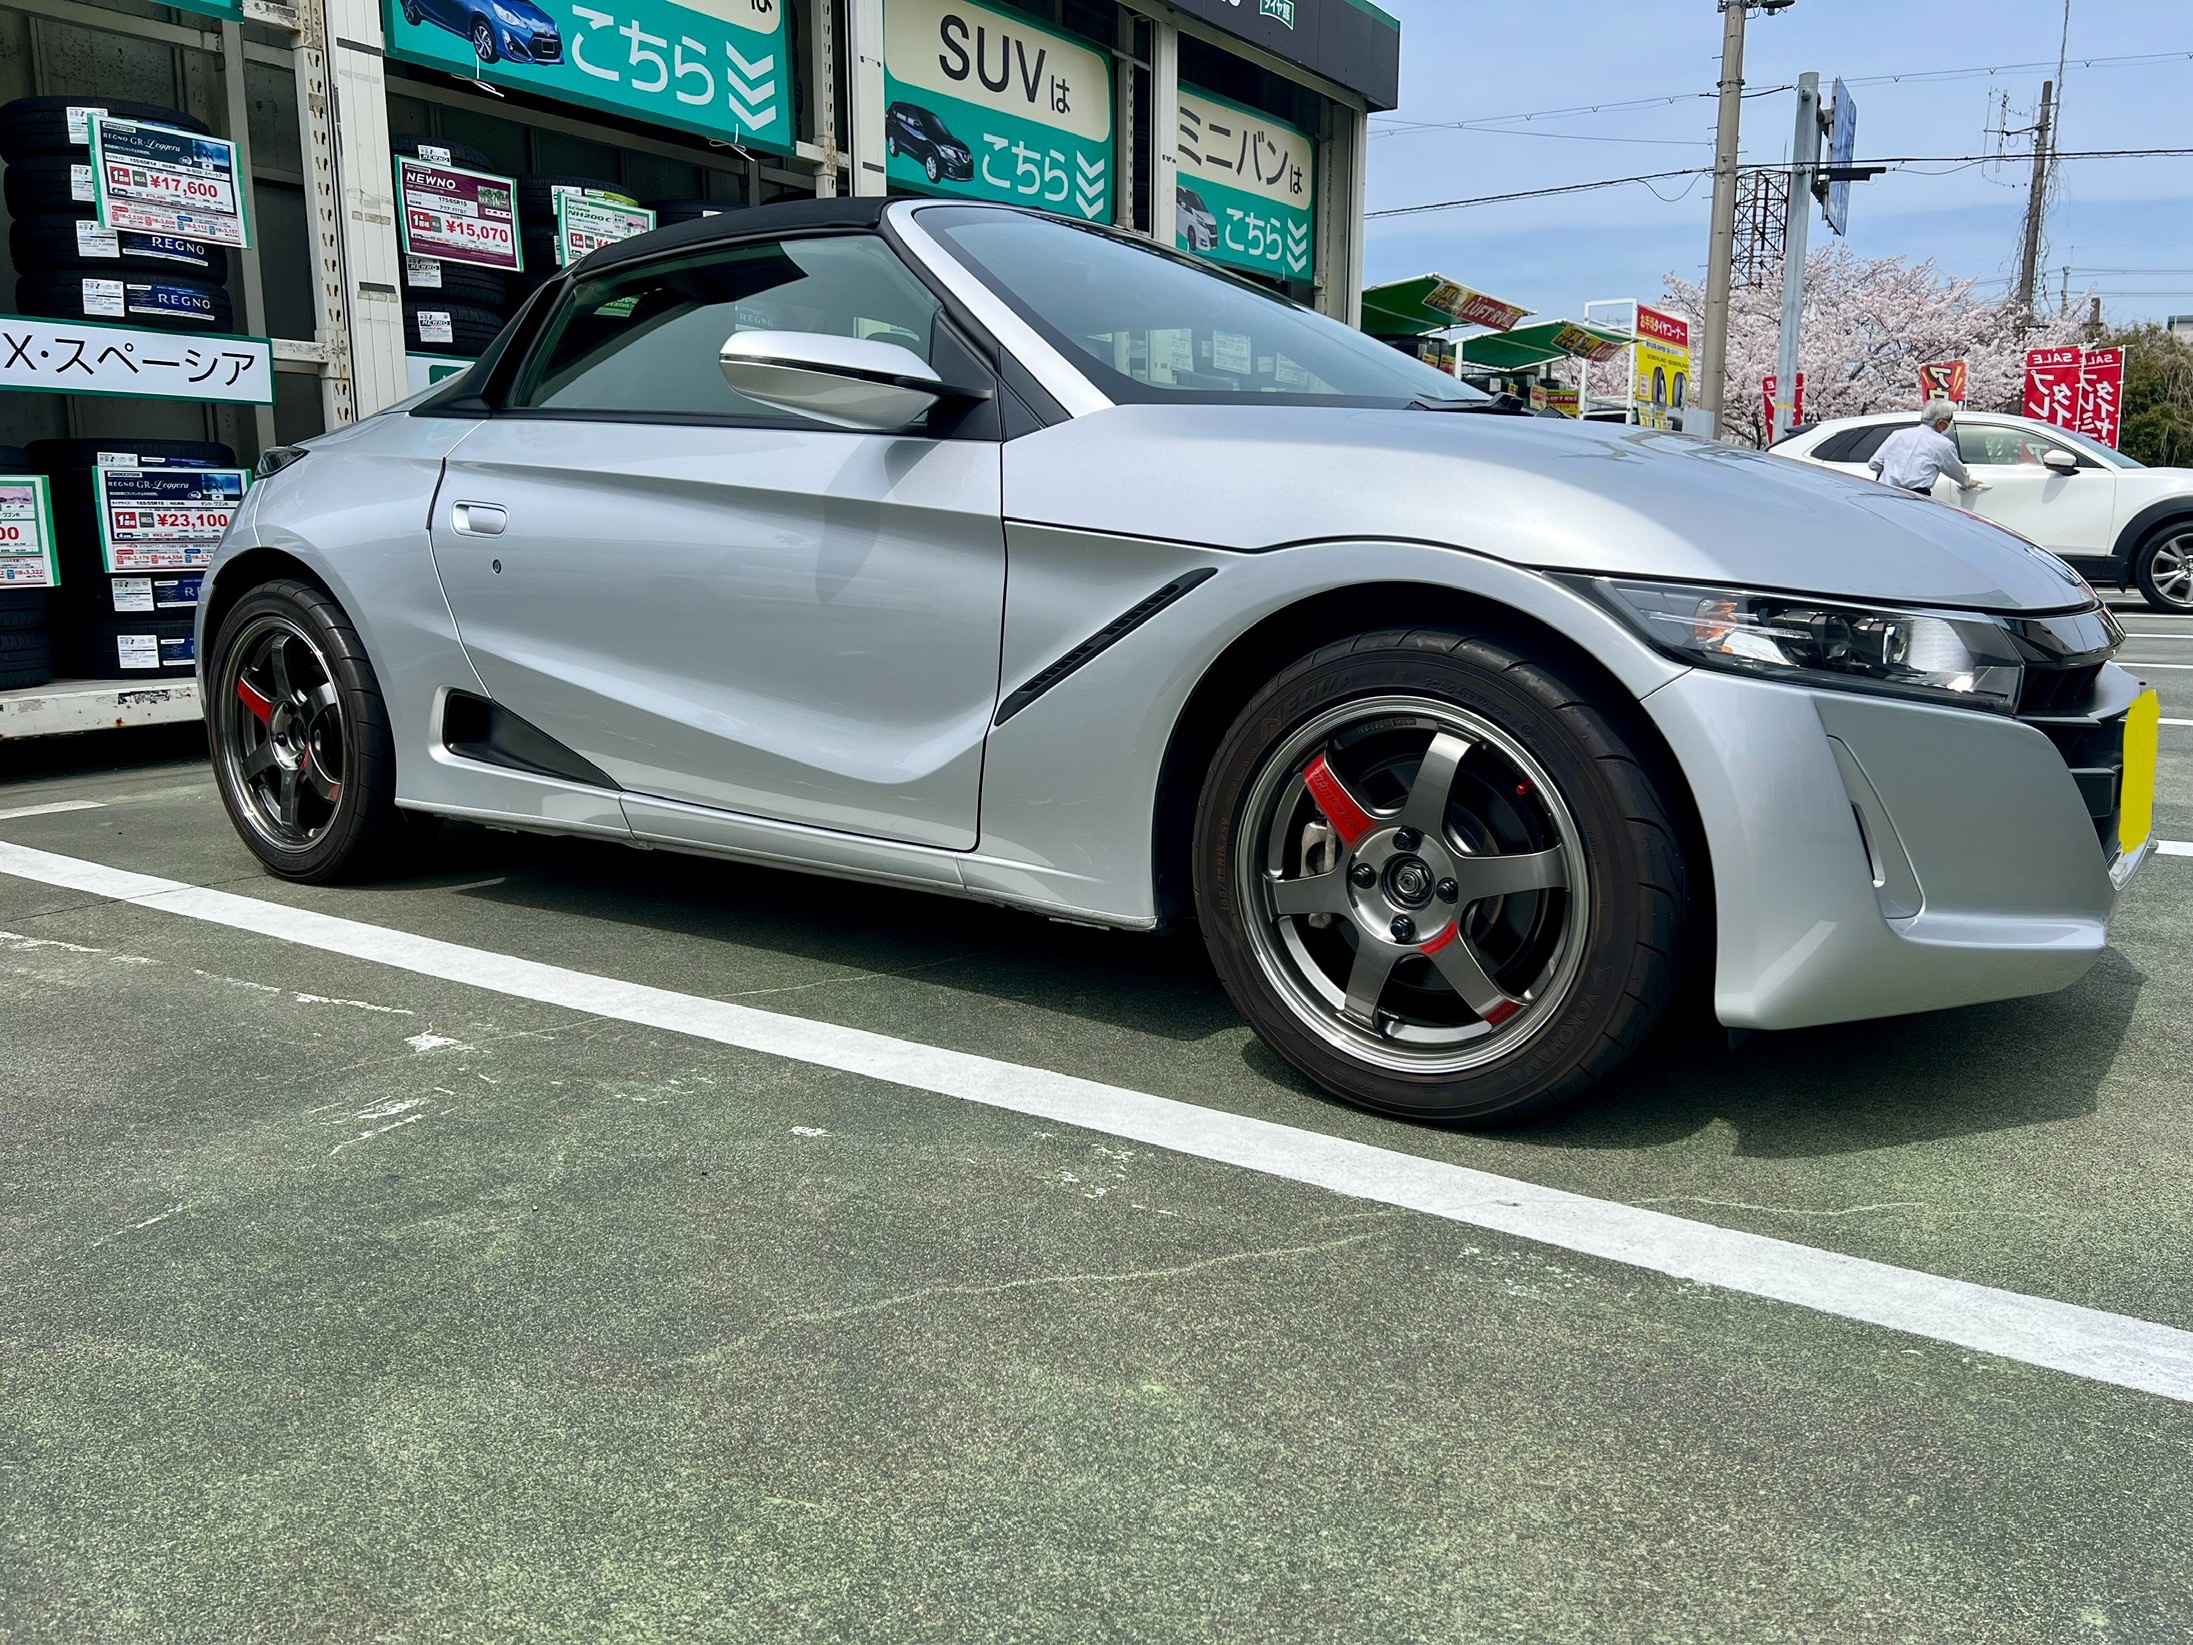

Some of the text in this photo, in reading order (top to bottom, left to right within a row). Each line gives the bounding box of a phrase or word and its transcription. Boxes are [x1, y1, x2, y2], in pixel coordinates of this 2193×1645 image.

[571, 4, 715, 105] こちら
[103, 132, 128, 142] REGNO
[1178, 106, 1302, 194] ミニバンは
[982, 132, 1068, 201] こちら
[150, 174, 218, 198] ¥17,600
[406, 172, 456, 189] NEWNO
[446, 220, 508, 243] ¥15,070
[1225, 207, 1283, 260] こちら
[152, 237, 205, 255] REGNO
[158, 293, 211, 309] REGNO
[740, 313, 772, 327] REGNO
[157, 513, 228, 530] ¥23,100
[1507, 993, 1600, 1083] YOKOHAMA
